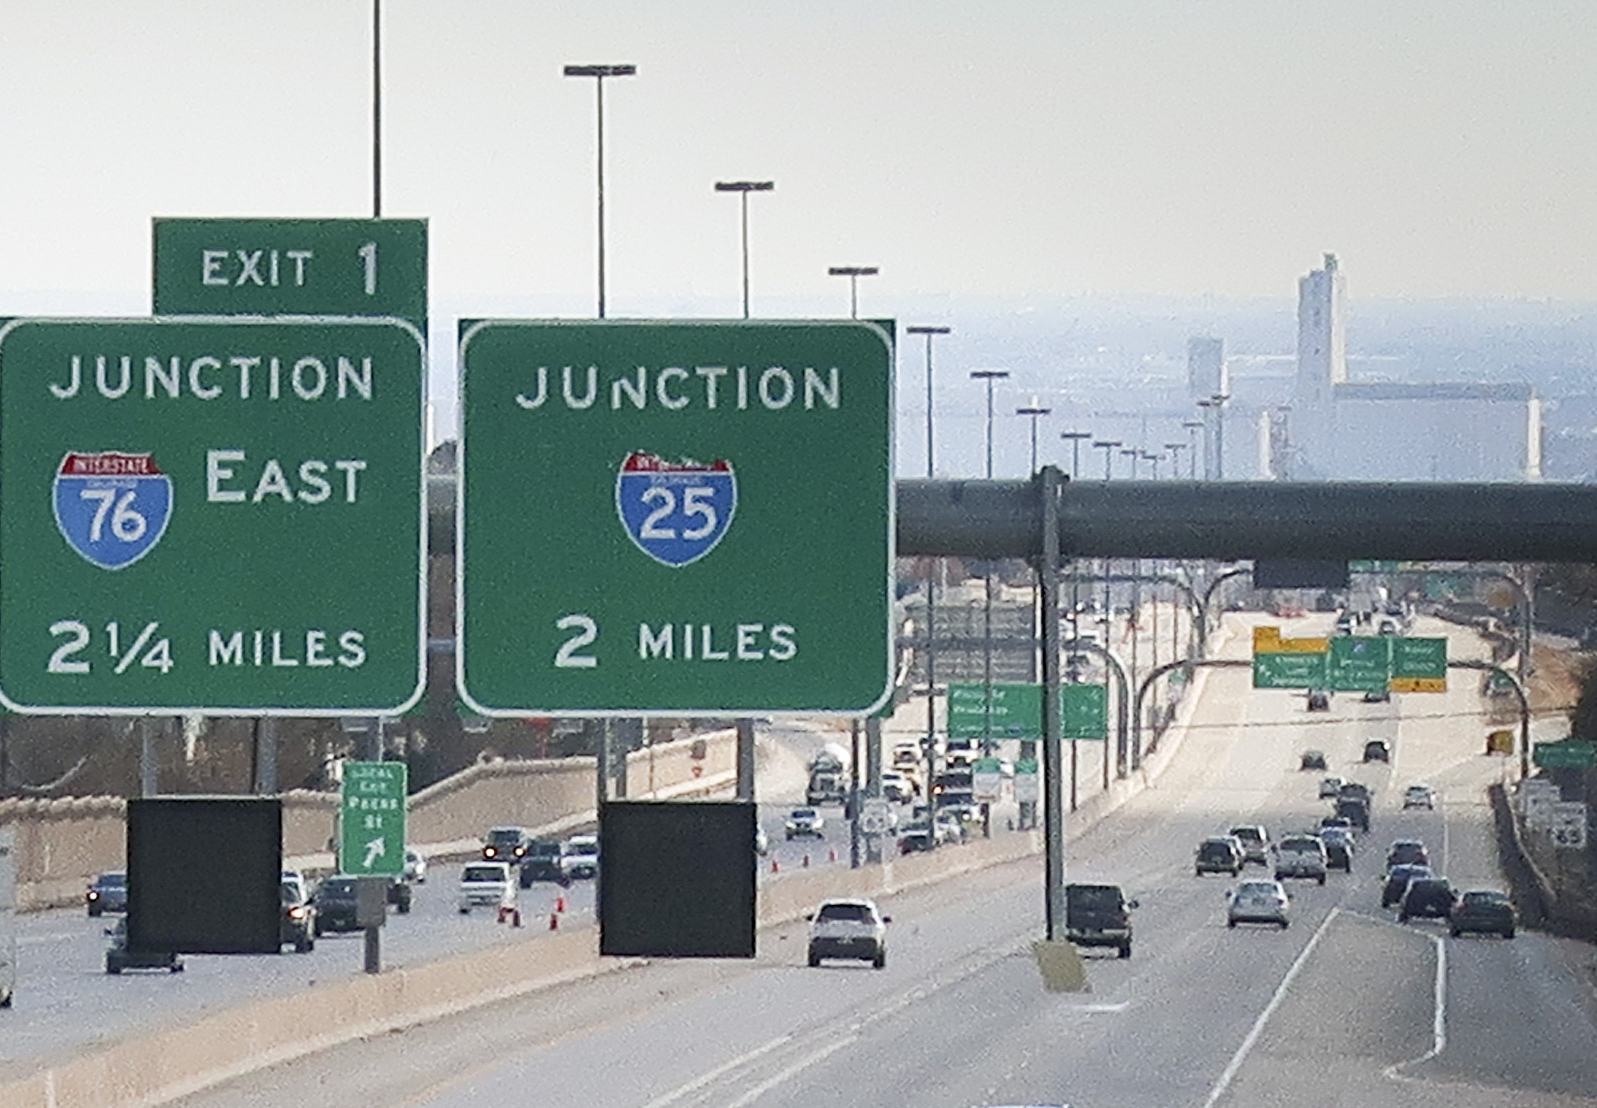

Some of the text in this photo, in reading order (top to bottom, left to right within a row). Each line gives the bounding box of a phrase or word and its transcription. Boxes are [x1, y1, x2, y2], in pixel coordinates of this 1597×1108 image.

[203, 243, 377, 296] EXIT 1
[50, 356, 374, 401] JUNCTION
[516, 367, 840, 411] JUNCTION
[80, 489, 147, 543] 76
[640, 486, 718, 541] 25
[208, 630, 368, 669] MILES
[556, 615, 798, 669] 2 MILES
